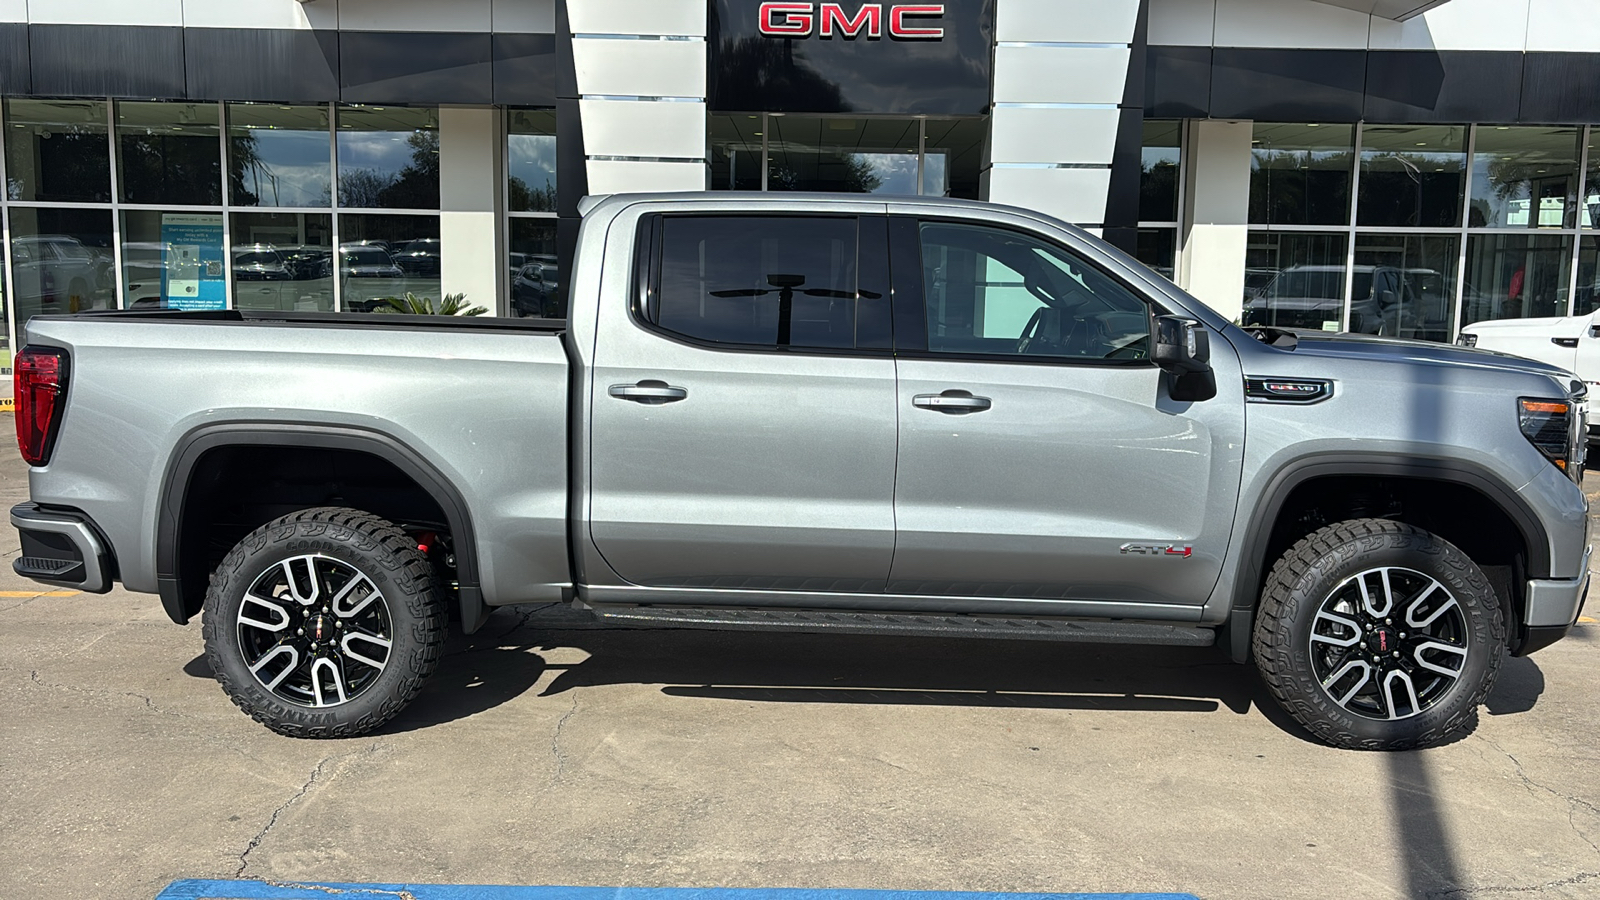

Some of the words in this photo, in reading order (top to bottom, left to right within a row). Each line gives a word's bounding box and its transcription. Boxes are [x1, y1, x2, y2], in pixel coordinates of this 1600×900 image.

[758, 1, 945, 40] GMC
[285, 540, 388, 583] GOODYEAR
[1120, 542, 1192, 559] AT4
[1434, 564, 1487, 643] OODYEAR
[244, 684, 338, 724] WRANGLER
[1294, 650, 1353, 729] WRANGLER
